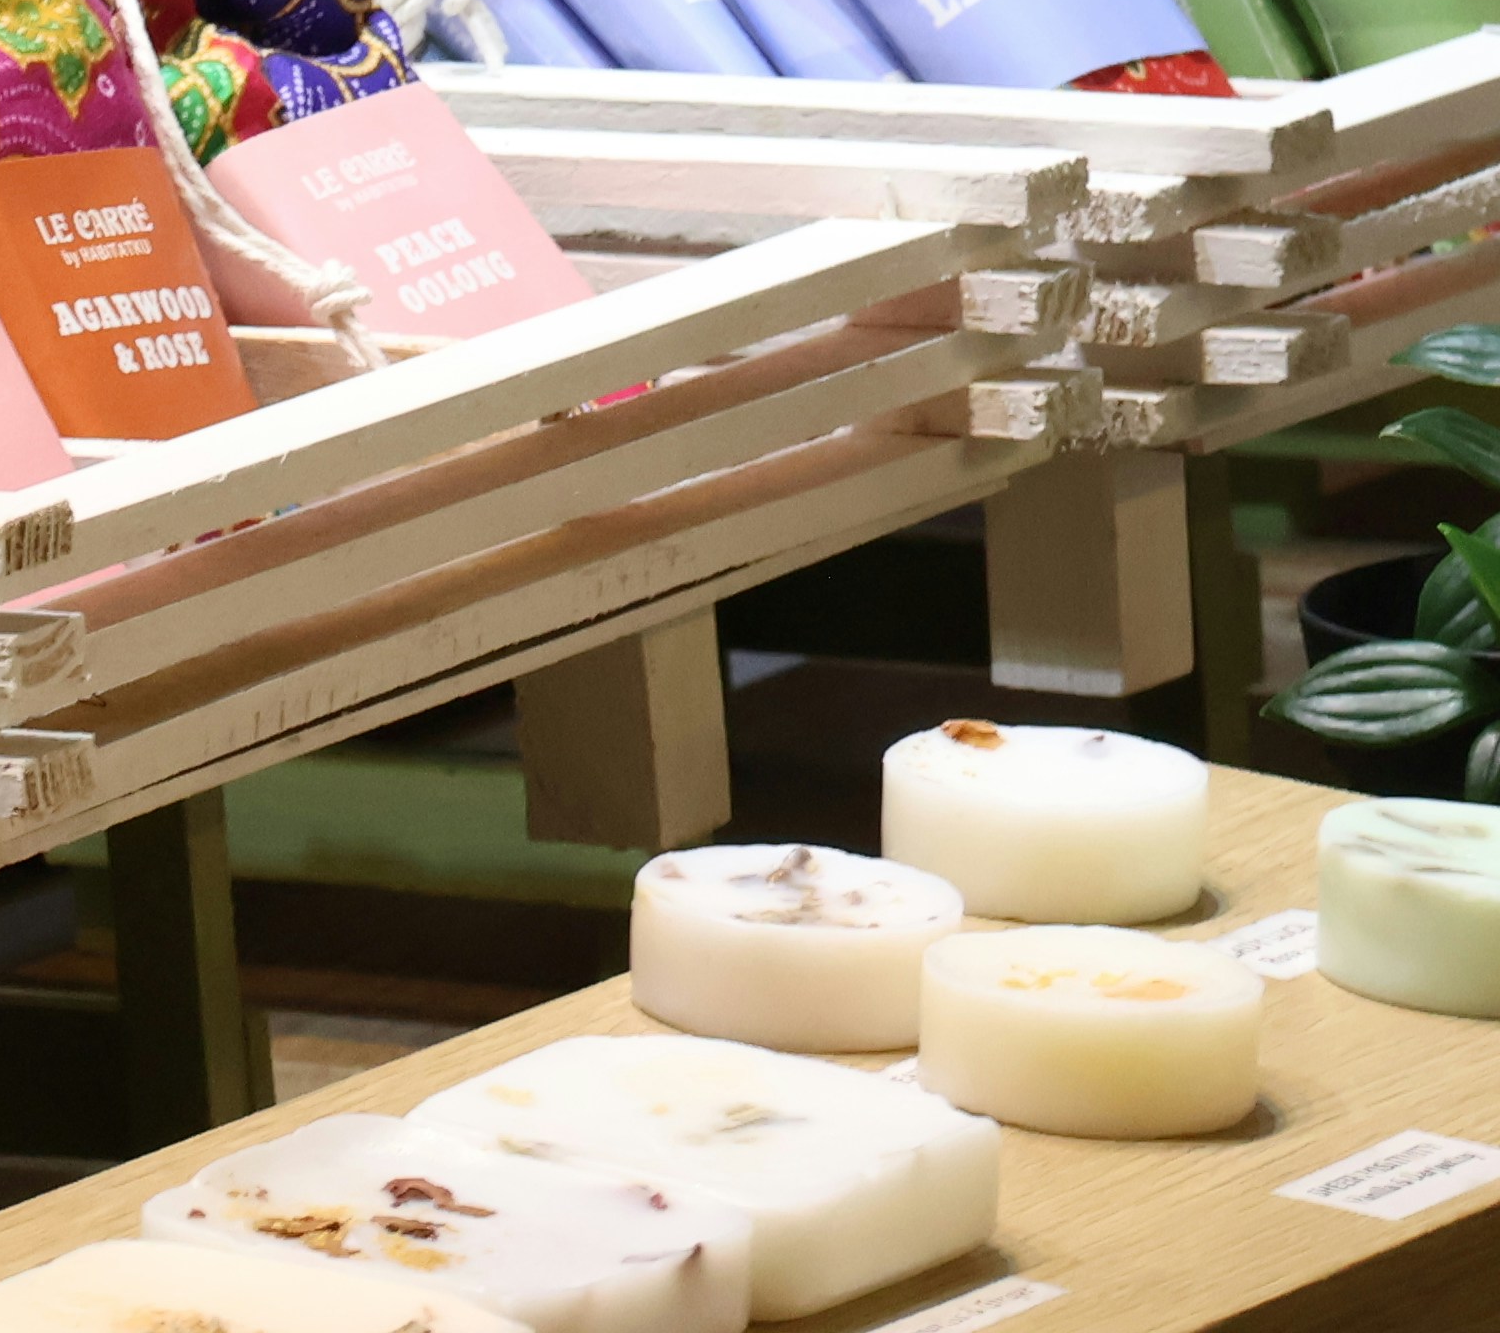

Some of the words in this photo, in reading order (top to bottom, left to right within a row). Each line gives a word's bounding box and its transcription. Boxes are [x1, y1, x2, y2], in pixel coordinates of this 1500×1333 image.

[300, 166, 344, 201] LE
[34, 213, 74, 245] LE
[73, 196, 155, 240] CARRÉ
[61, 249, 81, 269] by
[79, 238, 152, 263] HABITATKU
[374, 217, 477, 274] PEACH
[397, 250, 517, 314] OOLONG
[51, 285, 213, 336] AGARWOOD
[113, 342, 140, 374] &
[135, 331, 211, 371] ROSE
